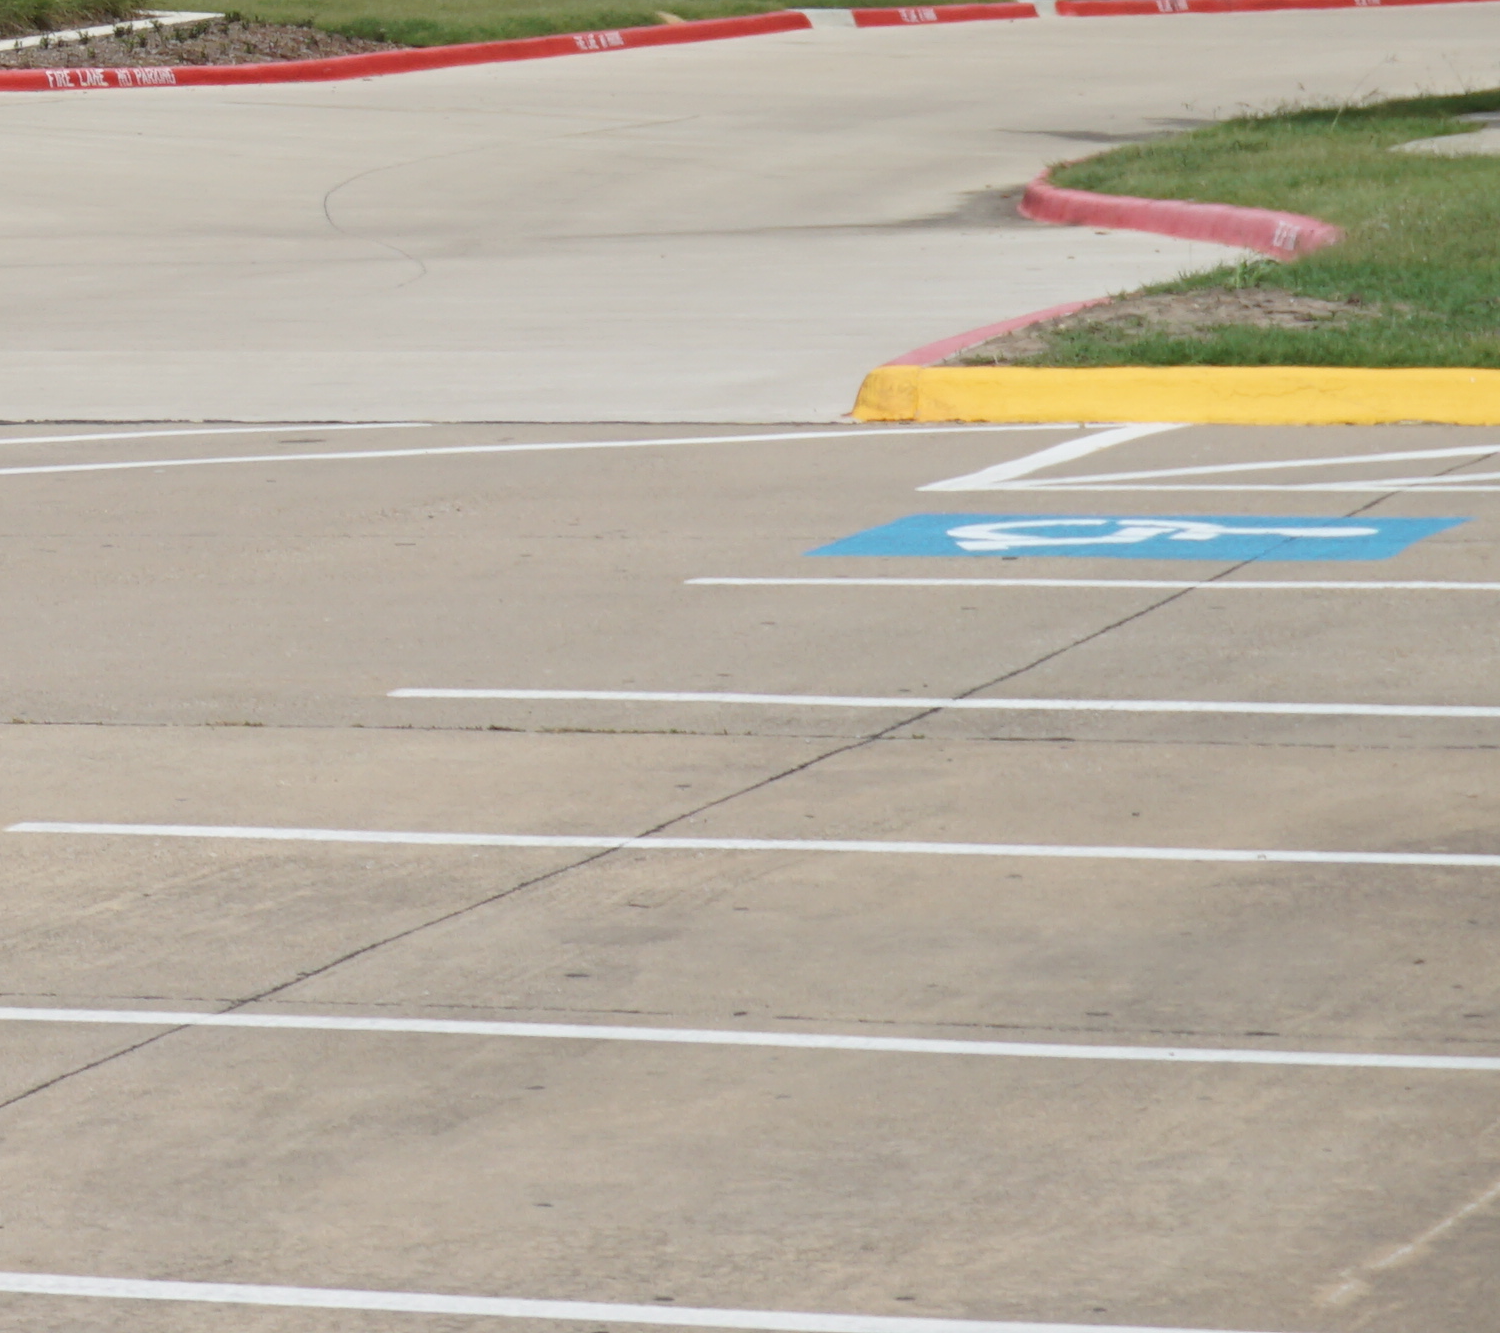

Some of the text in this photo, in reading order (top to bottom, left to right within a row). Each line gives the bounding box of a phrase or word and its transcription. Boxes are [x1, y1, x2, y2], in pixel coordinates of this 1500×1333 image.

[45, 69, 75, 88] FIRE
[75, 68, 109, 87] LANE
[133, 67, 177, 85] PARKING
